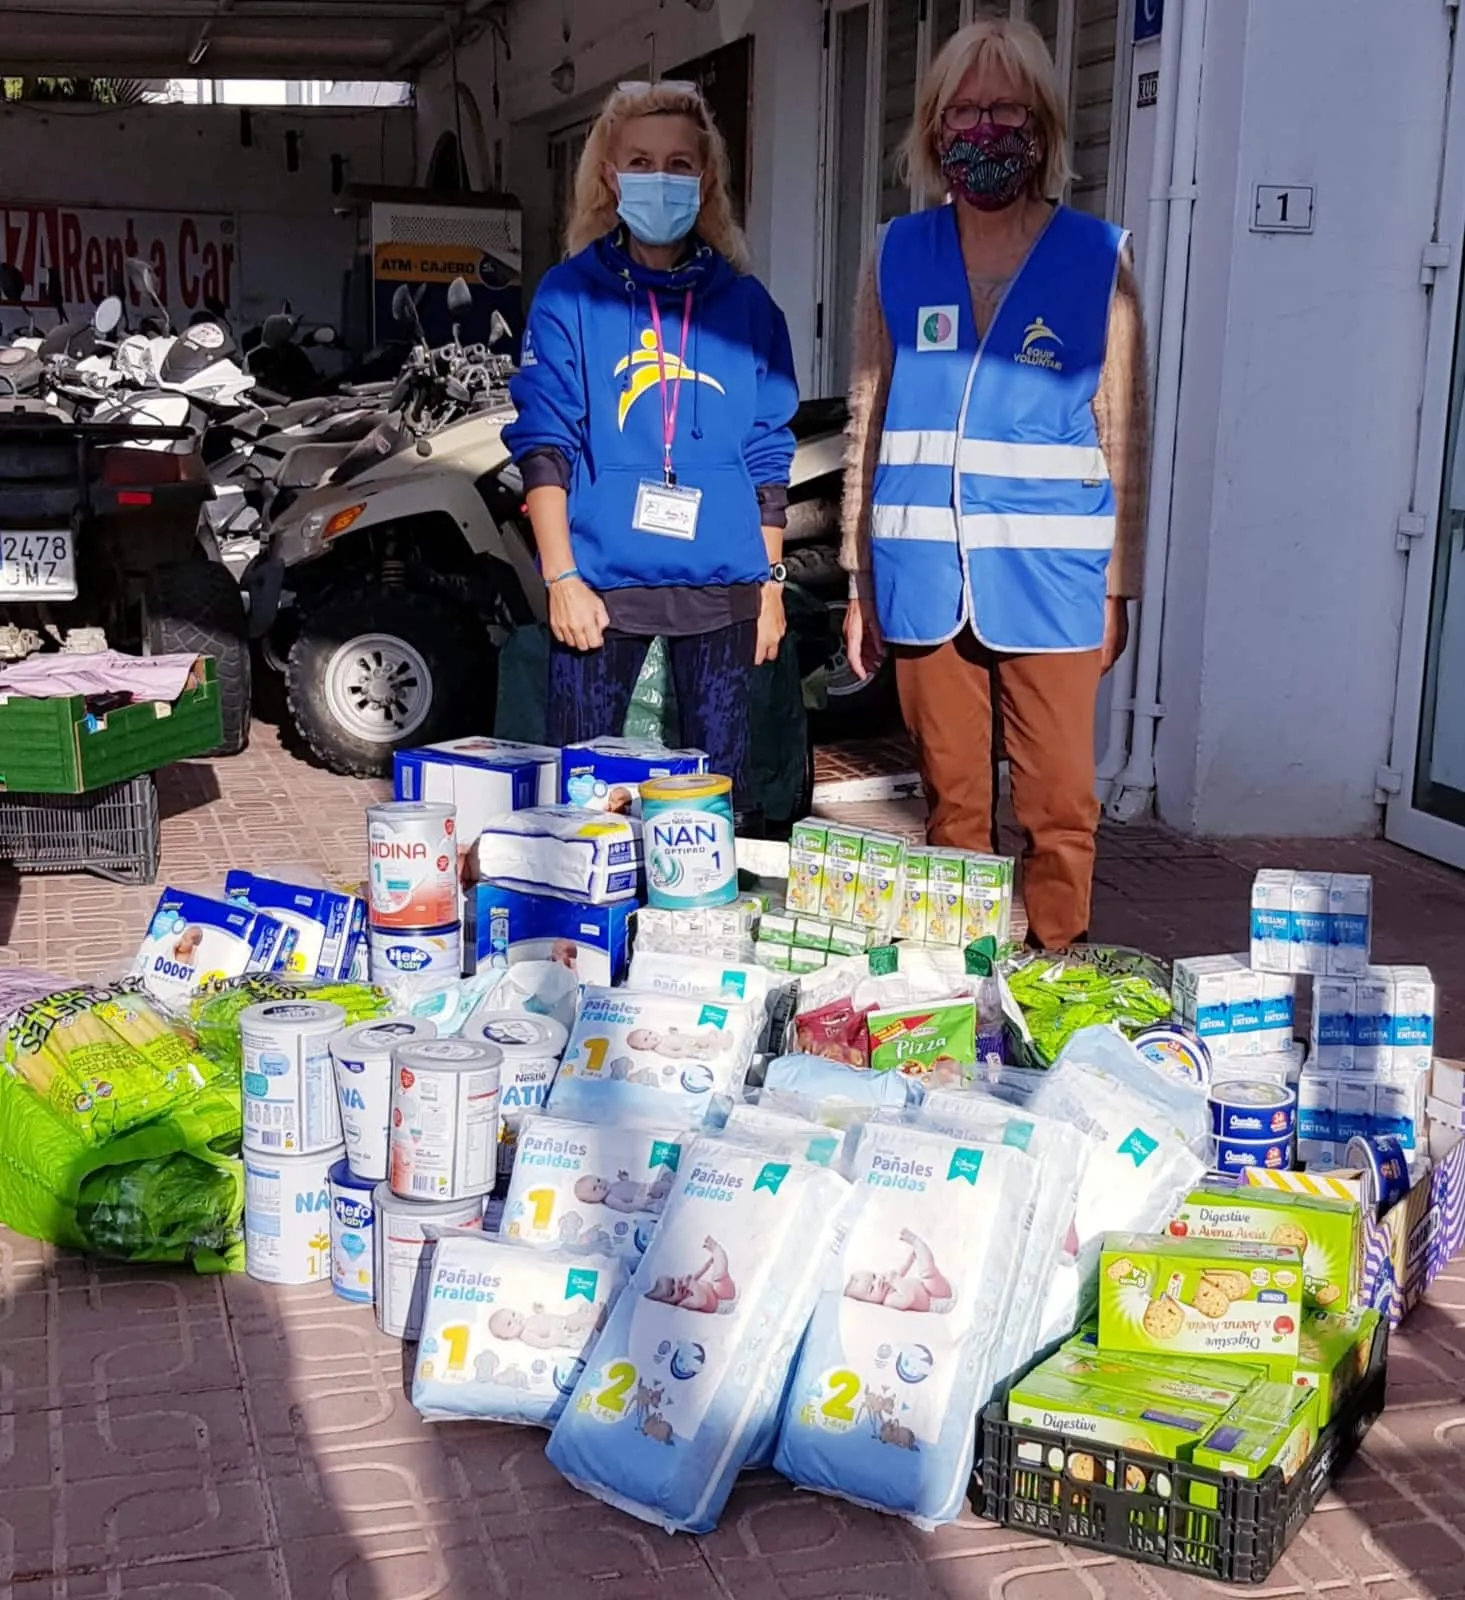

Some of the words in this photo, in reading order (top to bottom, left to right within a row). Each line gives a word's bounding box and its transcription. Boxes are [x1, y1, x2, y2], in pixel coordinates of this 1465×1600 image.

[1277, 192, 1289, 221] 1
[179, 218, 234, 309] Car
[381, 259, 412, 273] ATM
[420, 260, 476, 274] CAJERO
[3, 536, 67, 560] 2478
[653, 822, 716, 847] NAN
[711, 850, 721, 870] 1
[374, 862, 382, 883] 1
[390, 948, 427, 962] Hero
[154, 956, 195, 981] DODOT
[579, 1010, 635, 1025] Fraldas
[584, 1000, 642, 1015] Pañales
[583, 1037, 610, 1071] 1
[895, 1037, 947, 1058] Pizza
[515, 1072, 546, 1082] Nestlé
[524, 1136, 587, 1156] Pañales
[521, 1151, 581, 1170] Fraldas
[872, 1155, 934, 1177] Pañales
[690, 1167, 744, 1188] Pañales
[867, 1172, 927, 1192] Fraldas
[684, 1182, 734, 1202] Fraldas
[336, 1199, 372, 1219] Hero
[529, 1189, 556, 1230] 1
[1199, 1208, 1251, 1229] Digestive
[1199, 1227, 1233, 1239] Avena
[306, 1255, 317, 1276] 1
[436, 1268, 501, 1288] Pañales
[433, 1284, 496, 1304] Fraldas
[1187, 1320, 1220, 1332] Aveia
[1223, 1319, 1261, 1333] Avena
[442, 1324, 470, 1371] 1
[1205, 1332, 1261, 1350] Digestive
[596, 1362, 637, 1413] 2
[821, 1369, 861, 1422] 2
[1042, 1412, 1097, 1433] Digestive
